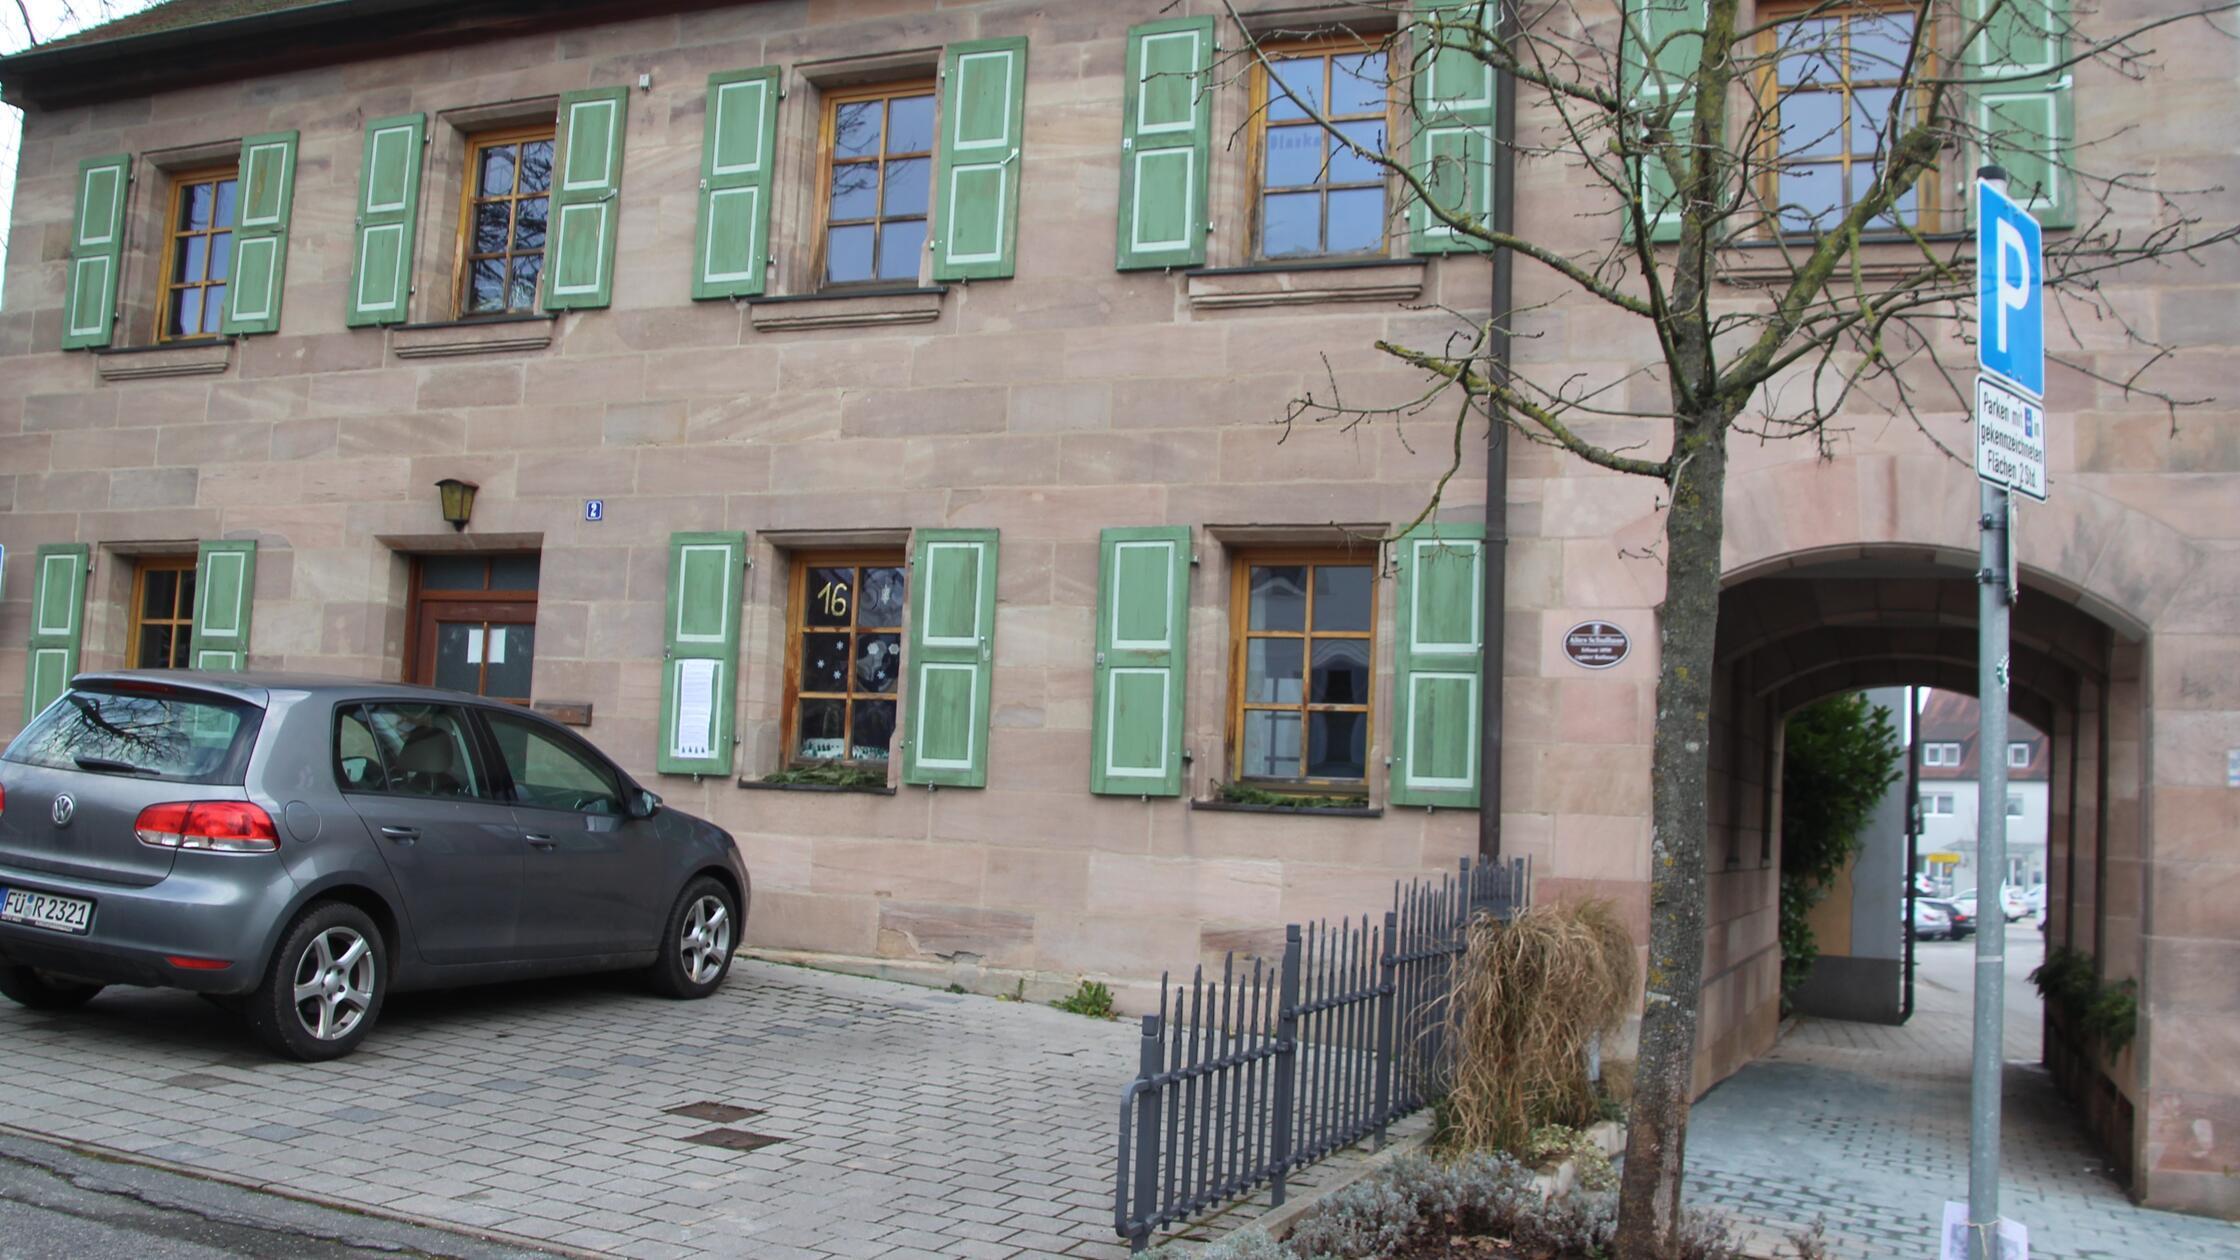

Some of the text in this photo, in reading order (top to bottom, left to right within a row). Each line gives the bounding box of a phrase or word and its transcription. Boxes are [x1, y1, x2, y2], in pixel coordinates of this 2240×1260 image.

[1997, 216, 2030, 353] P
[1983, 391, 2009, 422] Parken
[2012, 409, 2023, 429] mit
[1981, 422, 2042, 465] gekennzeichneten
[1988, 449, 2016, 480] Flächen
[590, 502, 598, 518] 2
[817, 581, 848, 617] 16
[4, 891, 27, 914] FÜ
[32, 896, 45, 918] R
[45, 899, 87, 926] 2321
